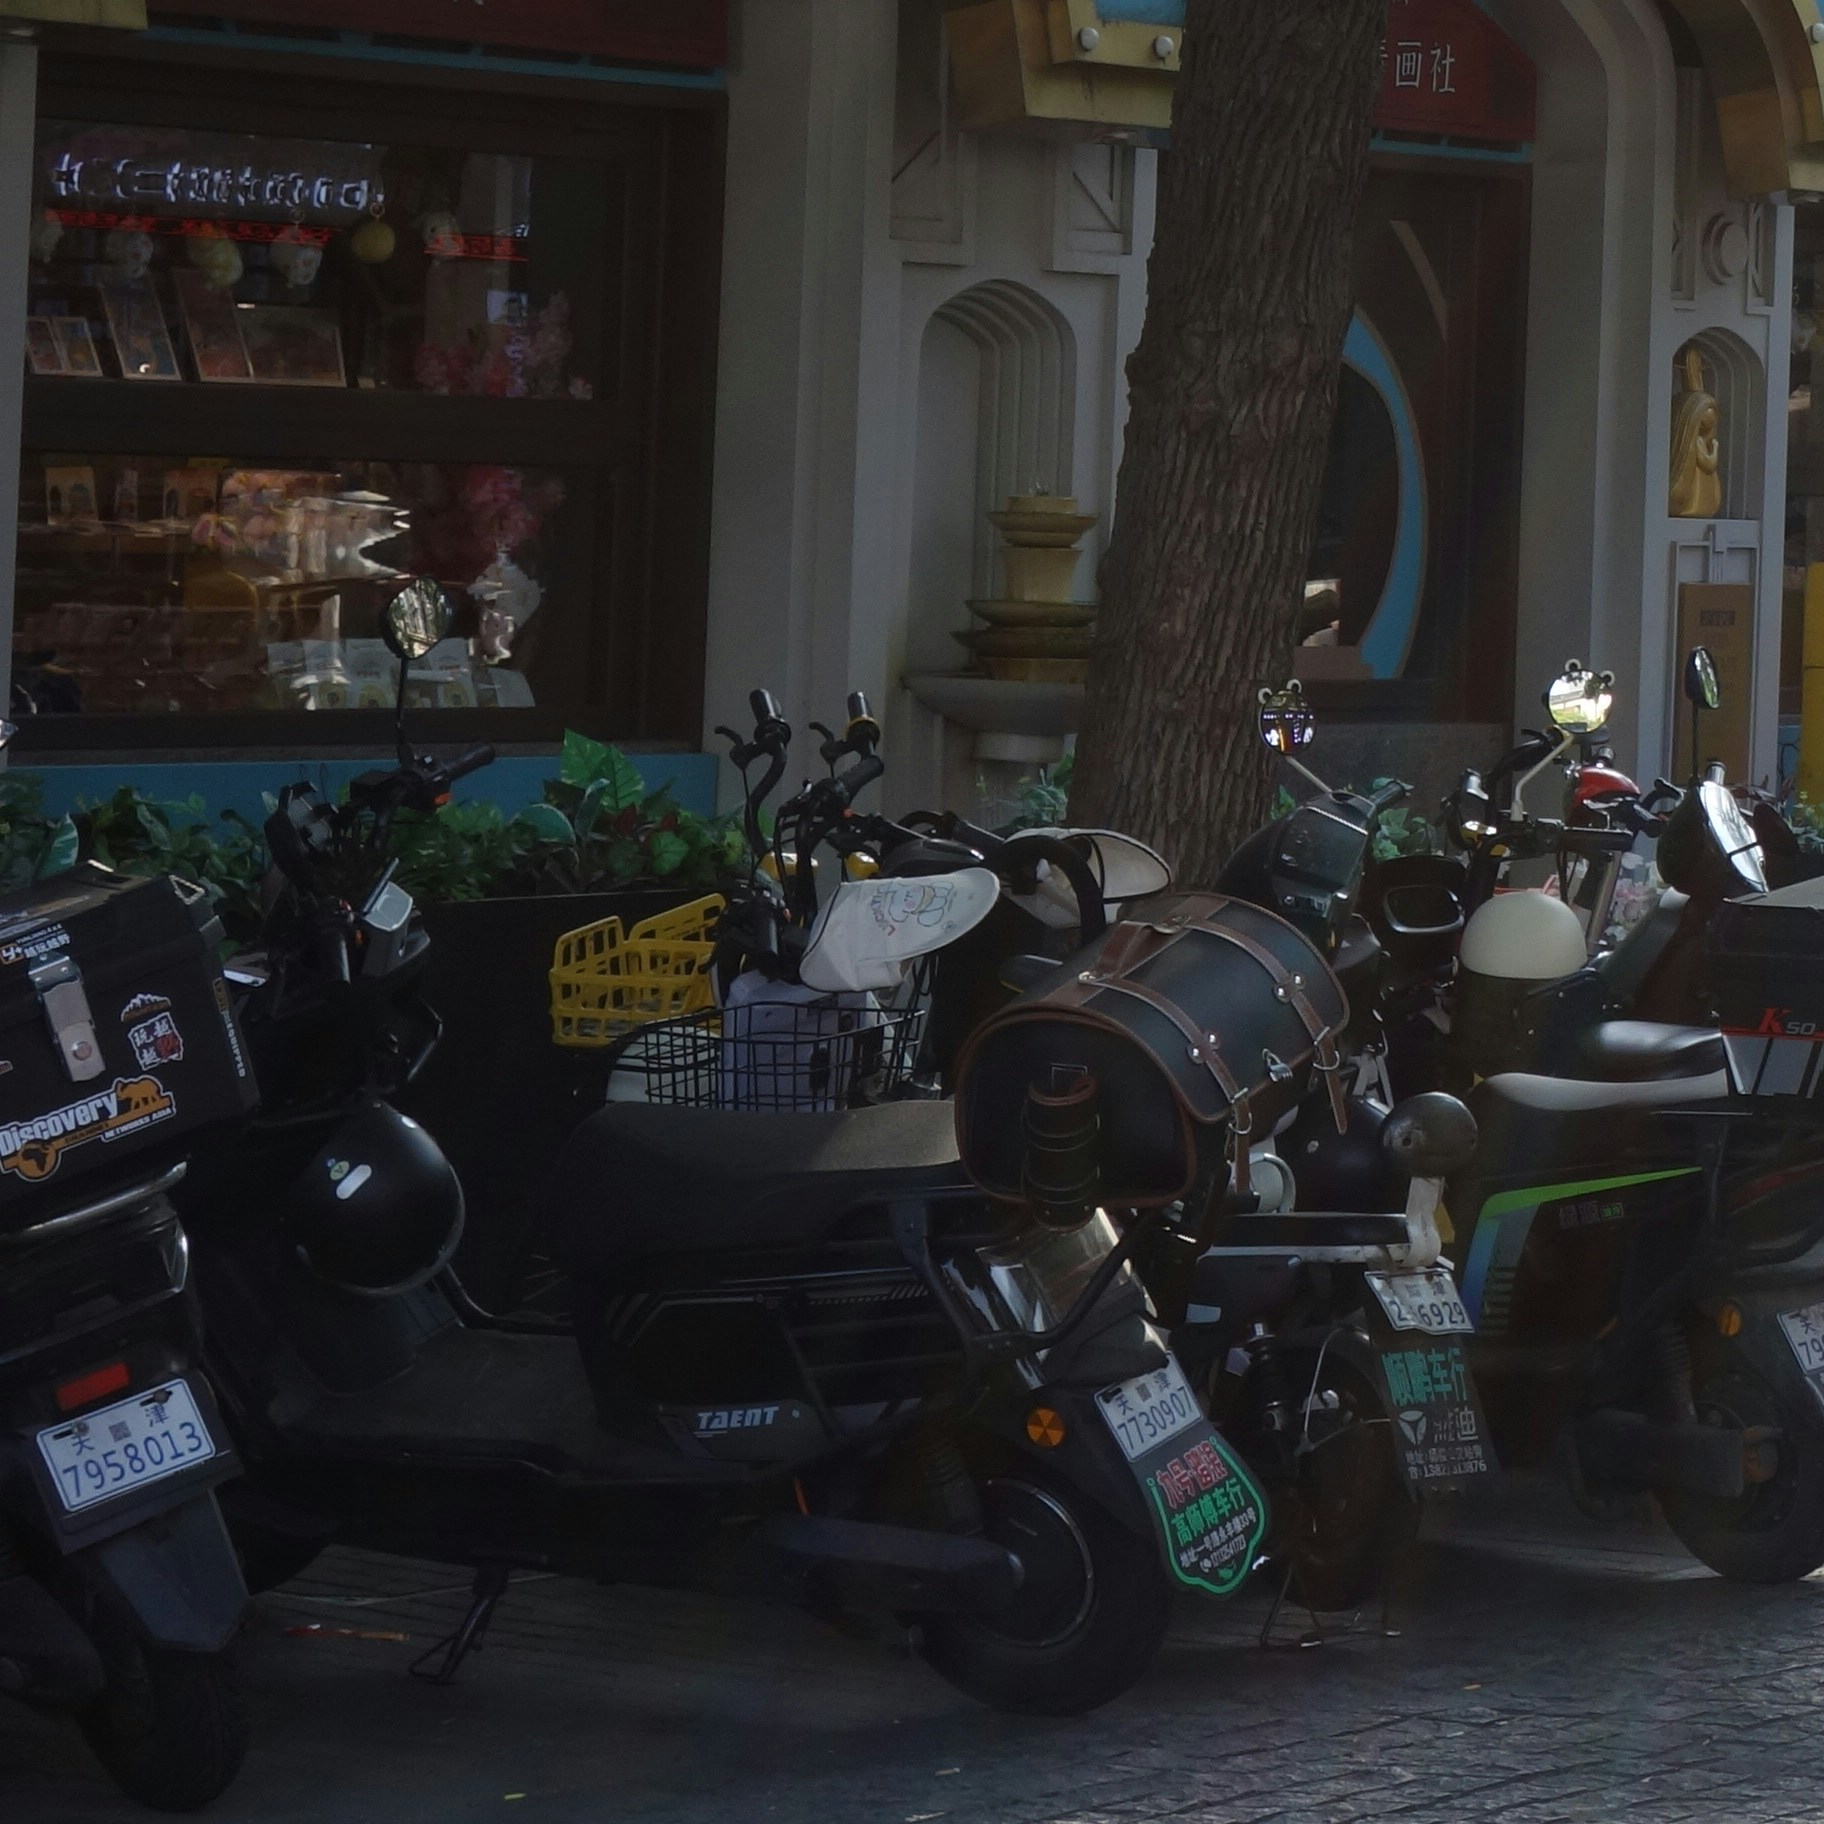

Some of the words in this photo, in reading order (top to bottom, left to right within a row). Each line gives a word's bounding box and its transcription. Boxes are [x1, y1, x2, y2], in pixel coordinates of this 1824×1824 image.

[1377, 39, 1457, 97] 画社
[71, 1434, 96, 1457] 天
[144, 1403, 170, 1428] 津
[1115, 1395, 1134, 1417] 天
[1116, 1386, 1194, 1451] 7730907
[61, 1420, 204, 1498] 7958013
